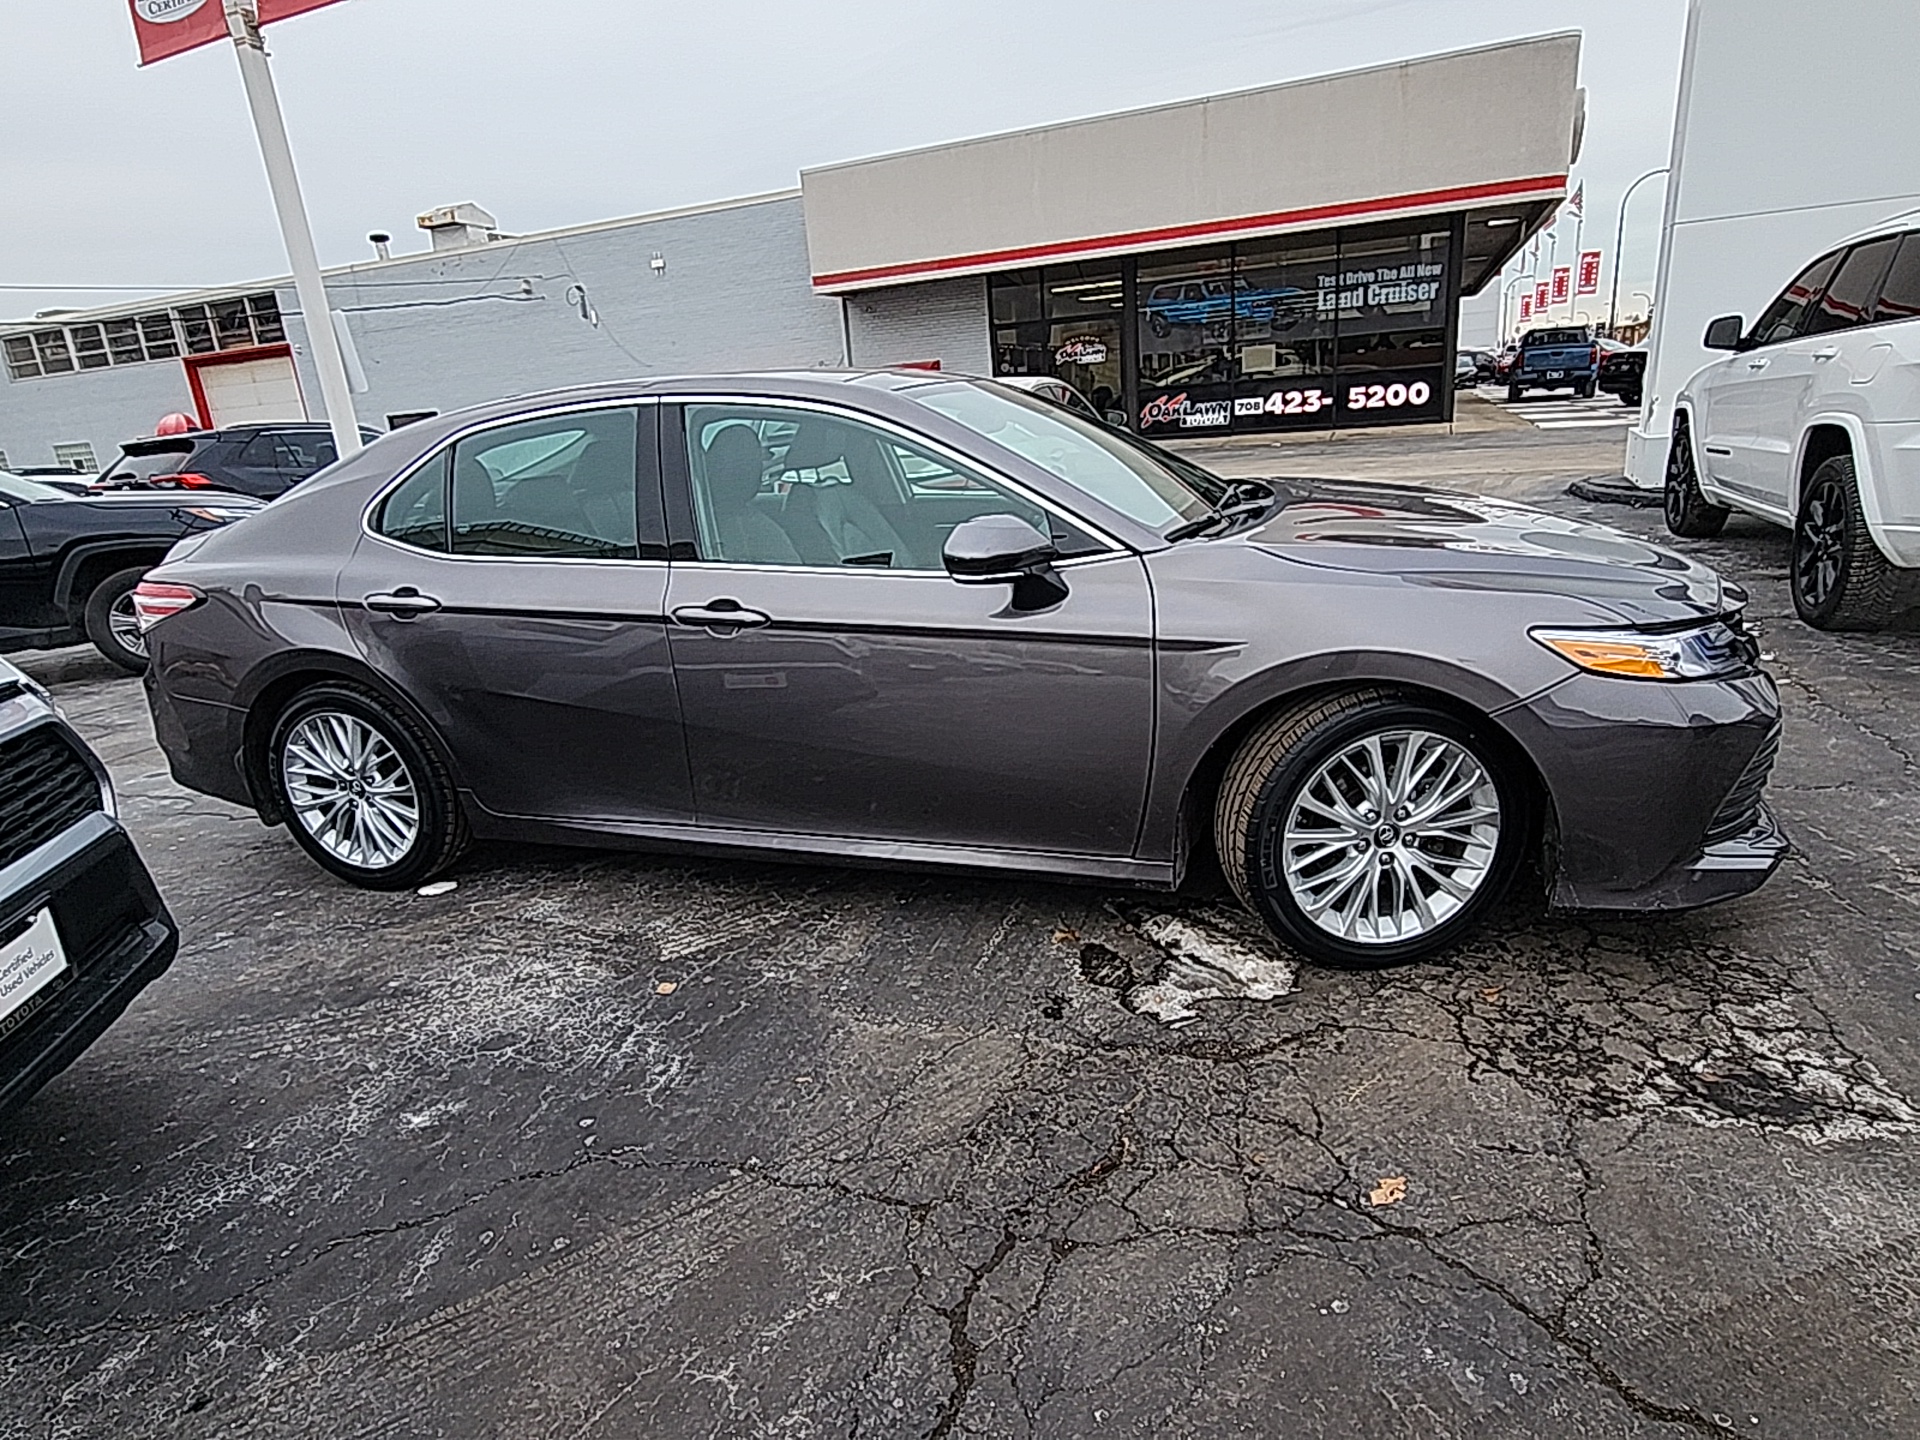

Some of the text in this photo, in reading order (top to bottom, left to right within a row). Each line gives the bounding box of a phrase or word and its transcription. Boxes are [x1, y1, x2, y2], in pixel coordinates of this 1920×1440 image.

[1346, 271, 1375, 286] Drive
[1376, 268, 1398, 281] The
[1399, 264, 1416, 279] All
[1417, 263, 1443, 277] New
[1316, 280, 1440, 310] Land Cruiser
[1236, 381, 1430, 414] 708 423- 5200
[0, 949, 55, 997] Used Vehicles
[0, 995, 44, 1034] TOYOTA
